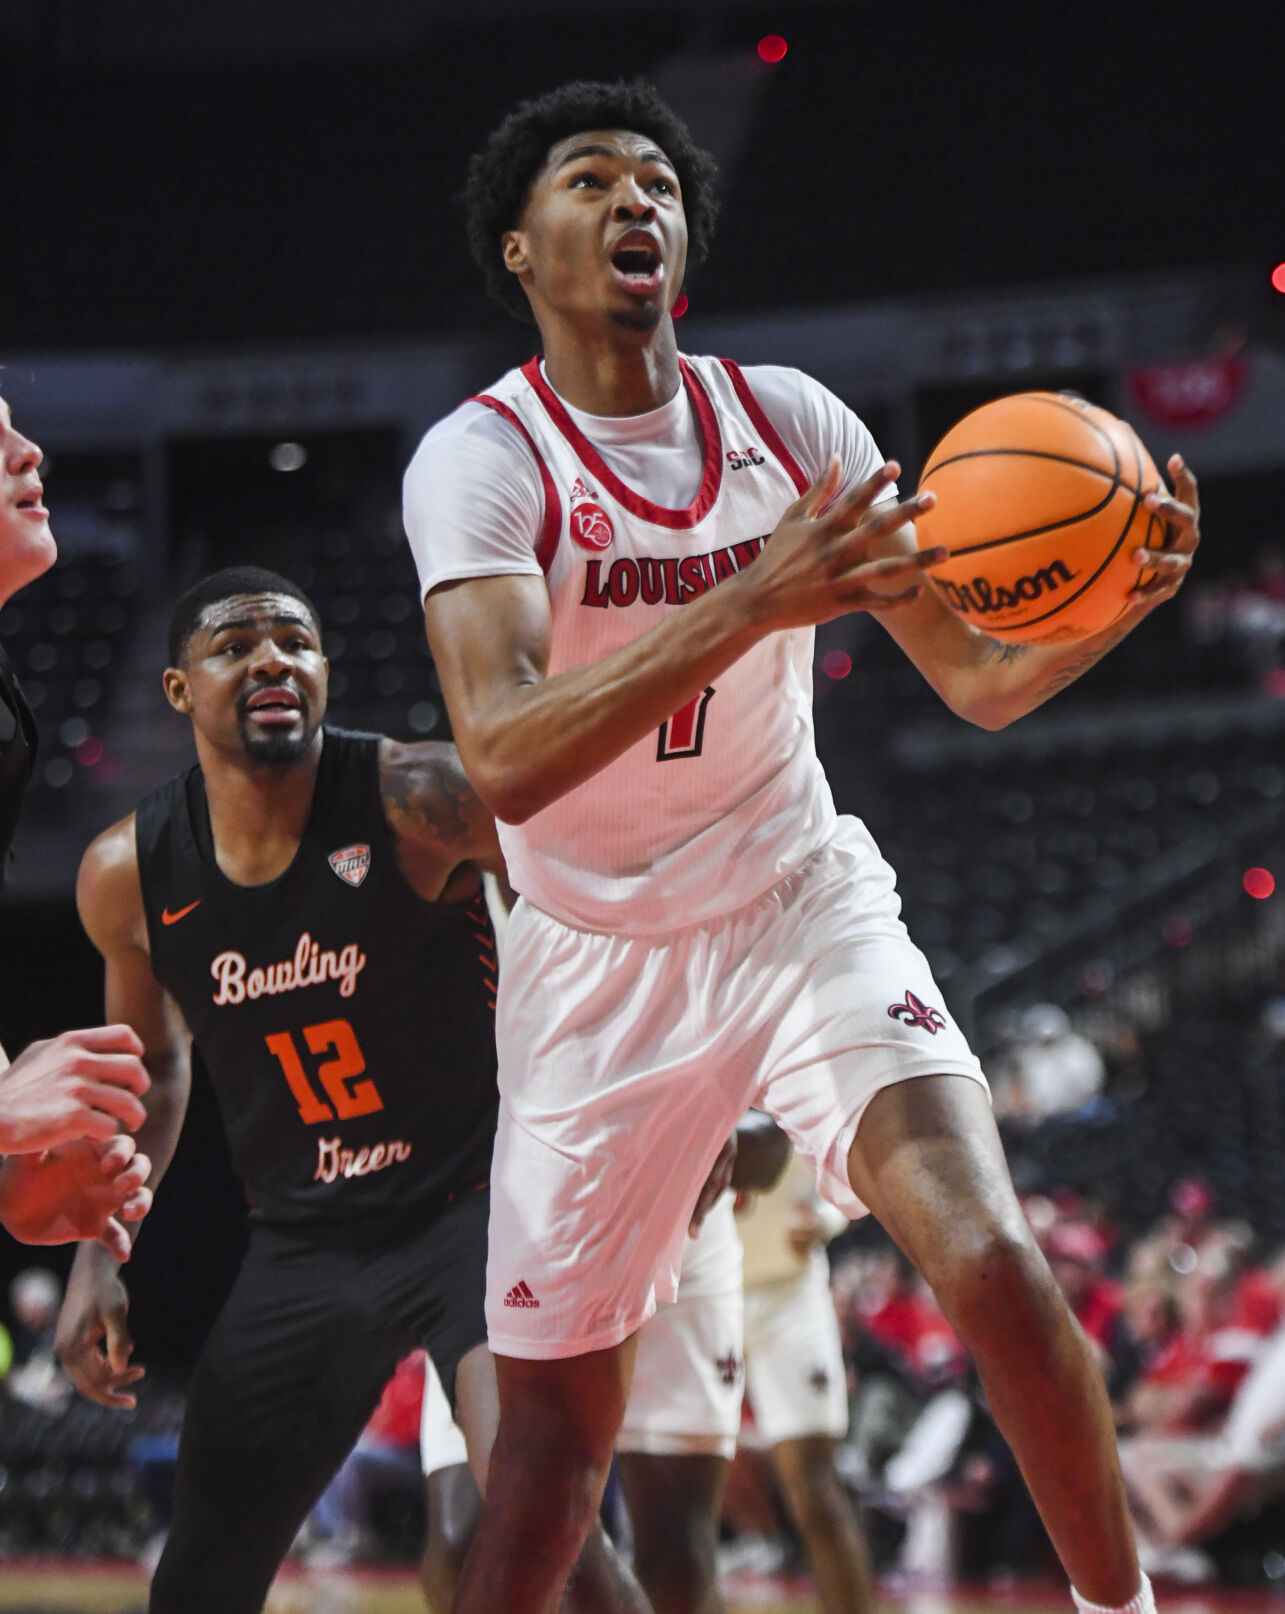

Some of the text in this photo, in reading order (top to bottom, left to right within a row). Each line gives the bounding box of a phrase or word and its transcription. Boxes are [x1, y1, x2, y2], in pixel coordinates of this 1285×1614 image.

[573, 511, 612, 547] 125
[581, 533, 773, 608] LOUISIA
[210, 932, 366, 1006] Bowling
[264, 1018, 384, 1125] 12
[313, 1136, 412, 1183] Green
[503, 1297, 540, 1308] adidas
